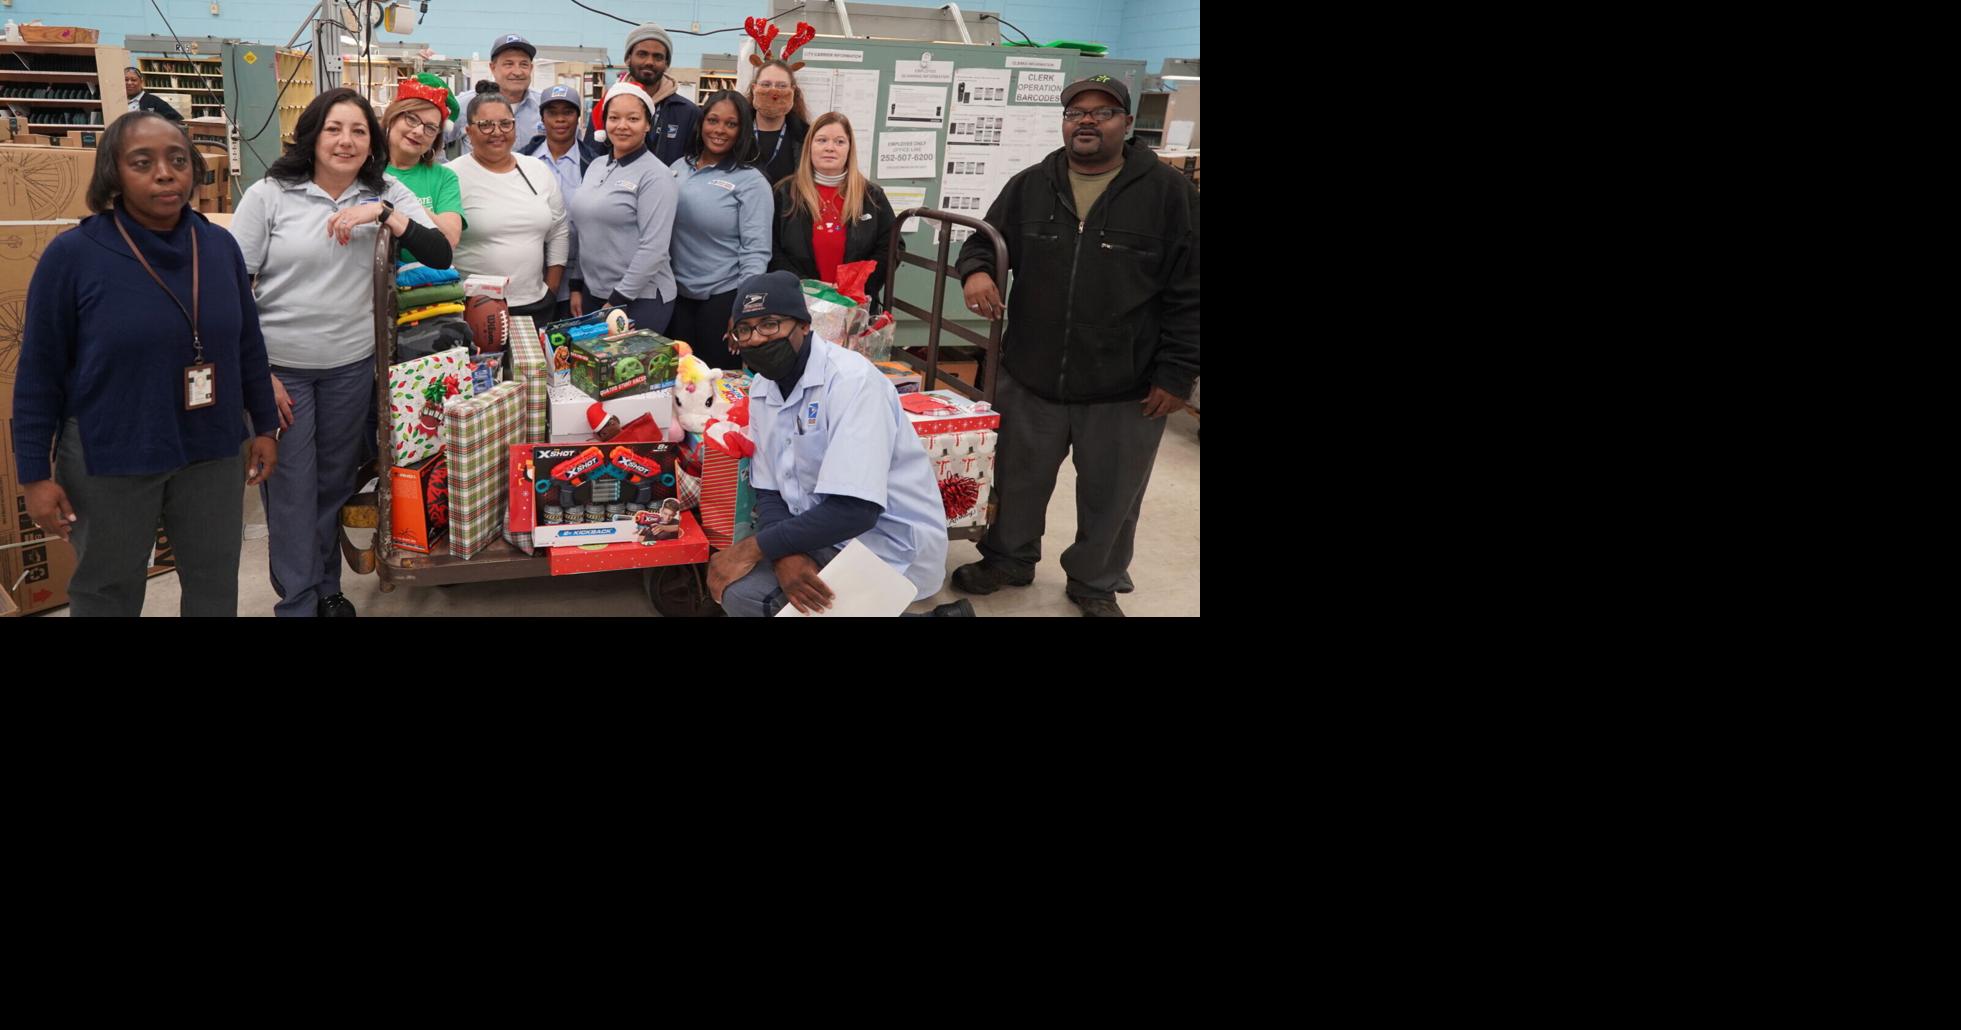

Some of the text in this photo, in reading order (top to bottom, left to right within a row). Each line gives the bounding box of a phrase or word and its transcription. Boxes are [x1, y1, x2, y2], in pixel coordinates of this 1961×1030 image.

[1028, 73, 1055, 82] CLERK
[1017, 83, 1062, 92] OPERATION
[1016, 93, 1060, 102] BARCODES
